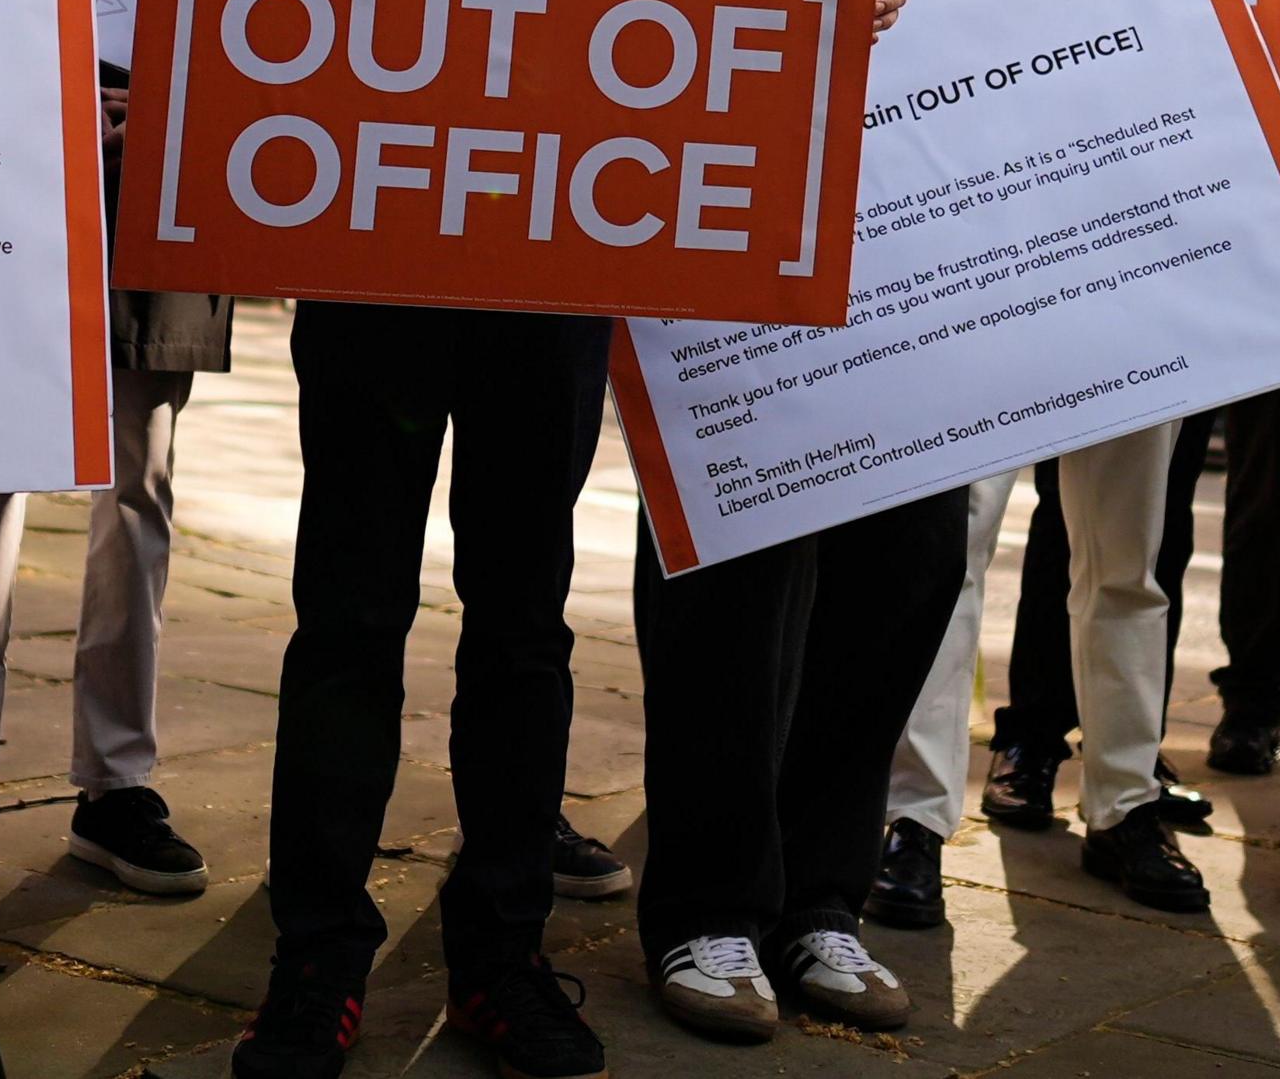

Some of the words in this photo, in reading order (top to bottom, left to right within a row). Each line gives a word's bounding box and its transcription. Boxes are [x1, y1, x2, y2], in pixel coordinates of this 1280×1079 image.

[863, 103, 904, 131] ain
[905, 74, 976, 122] [OUT
[983, 60, 1025, 91] OF
[1030, 25, 1145, 77] OFFICE]
[705, 454, 749, 479] Best,
[713, 474, 754, 499] John
[754, 457, 803, 484] Smith
[803, 431, 877, 472] (He/Him)
[716, 486, 777, 518] Liberal
[775, 460, 859, 499] Democrat
[858, 431, 946, 472] Controlled
[945, 416, 996, 444] South
[996, 377, 1126, 427] Cambridgeshire
[1125, 354, 1190, 386] Council
